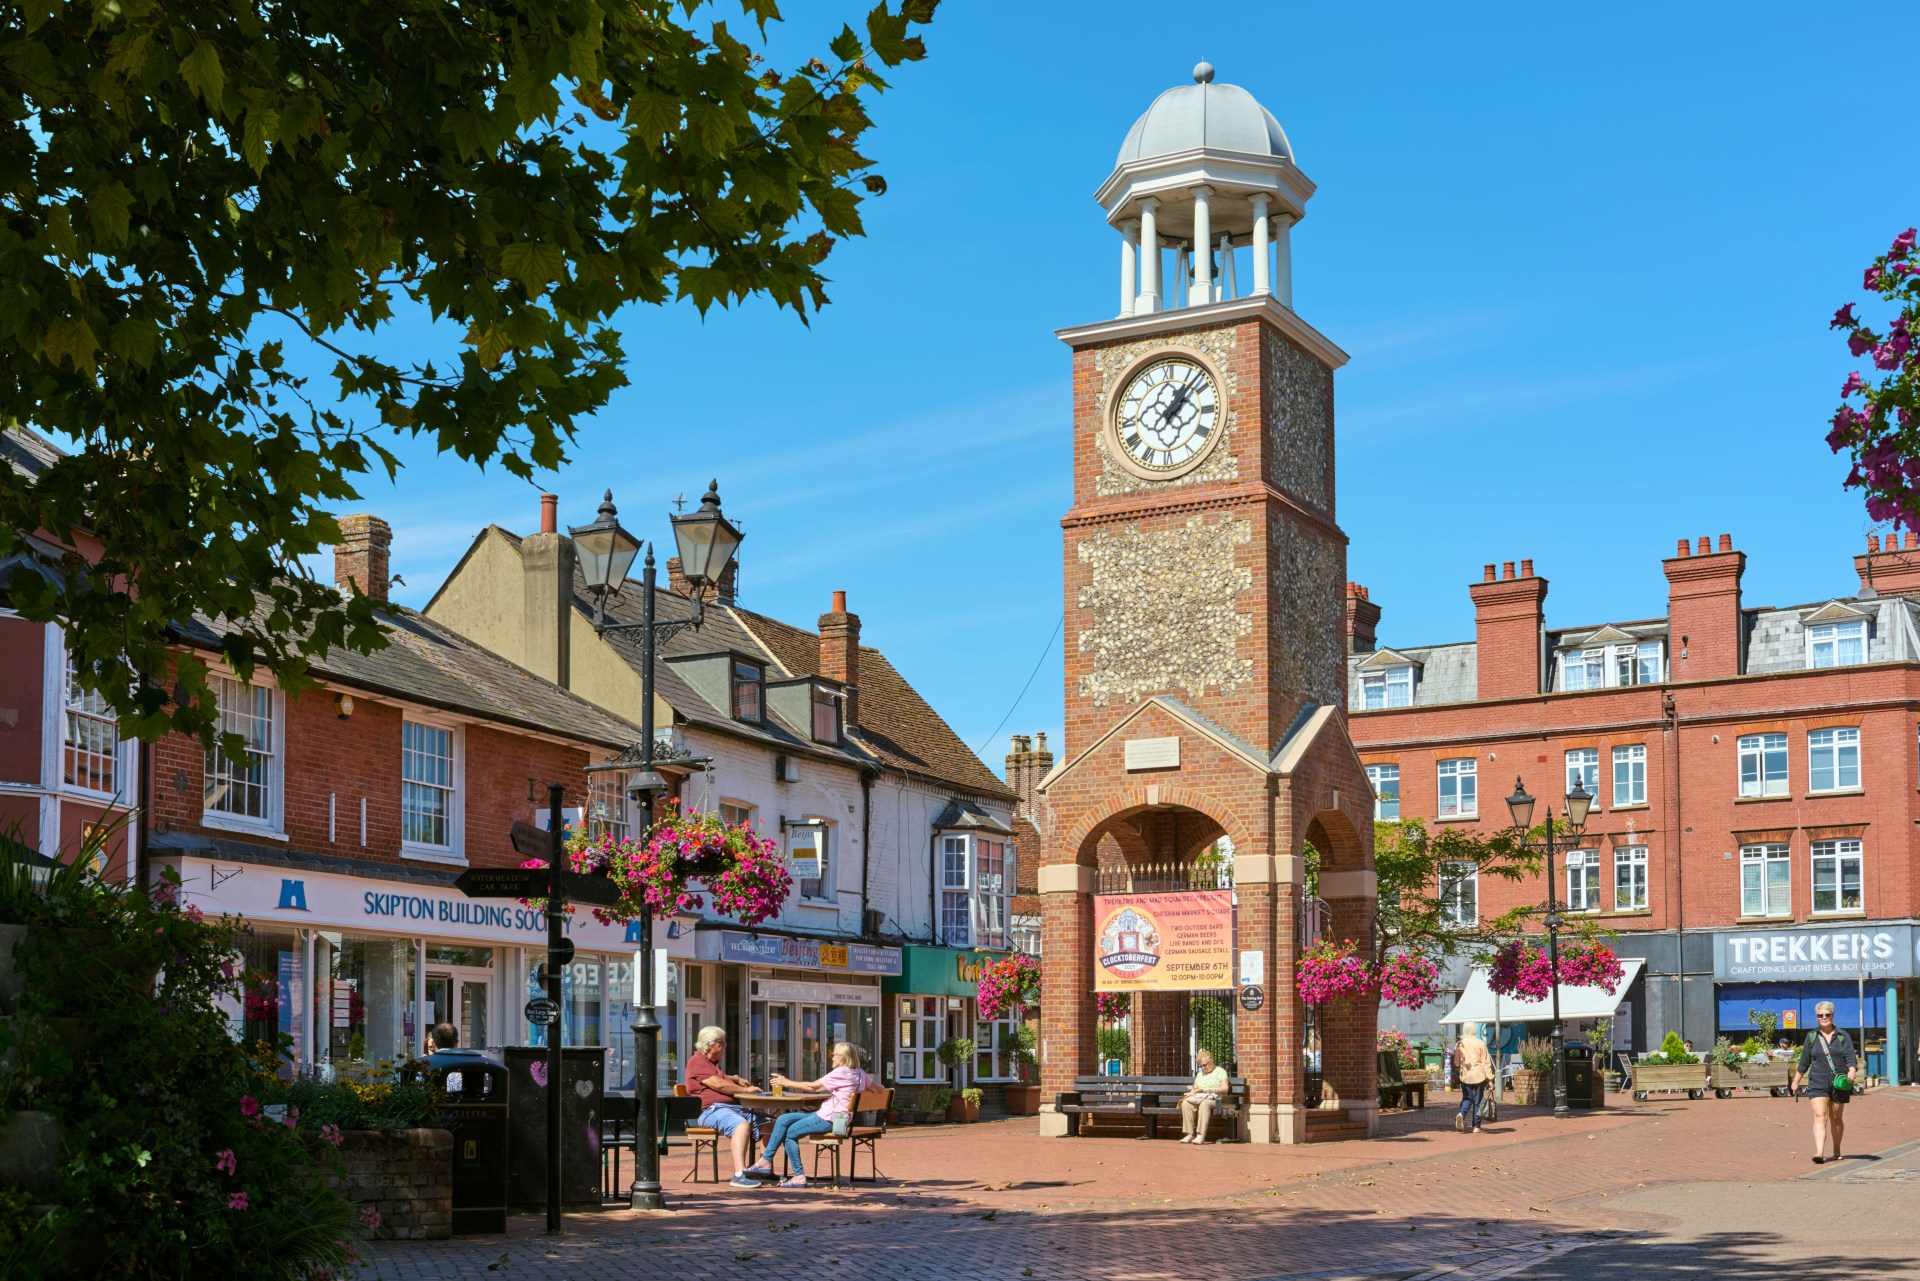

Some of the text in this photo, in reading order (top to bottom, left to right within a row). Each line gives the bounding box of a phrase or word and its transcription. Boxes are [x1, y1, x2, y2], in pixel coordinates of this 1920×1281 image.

[471, 874, 530, 882] WATERMEADOW
[480, 883, 520, 891] CAR PARK
[1104, 898, 1134, 906] TREKKERS
[364, 891, 572, 935] SKIPTON BUILDING SOCY
[1153, 906, 1231, 918] CHESHAM MARKET SQUARE
[781, 938, 820, 963] Beijing
[1729, 932, 1894, 963] TREKKERS
[1102, 953, 1157, 967] CLOCKTOBERFEST
[1166, 962, 1229, 972] SEPTEMBER 6TH
[1731, 966, 1756, 975] CRAFT
[1789, 964, 1811, 973] LIGHT
[1813, 964, 1832, 972] BITES
[1834, 963, 1841, 971] &
[1842, 962, 1870, 971] BOTLE
[1872, 962, 1895, 971] SHOP
